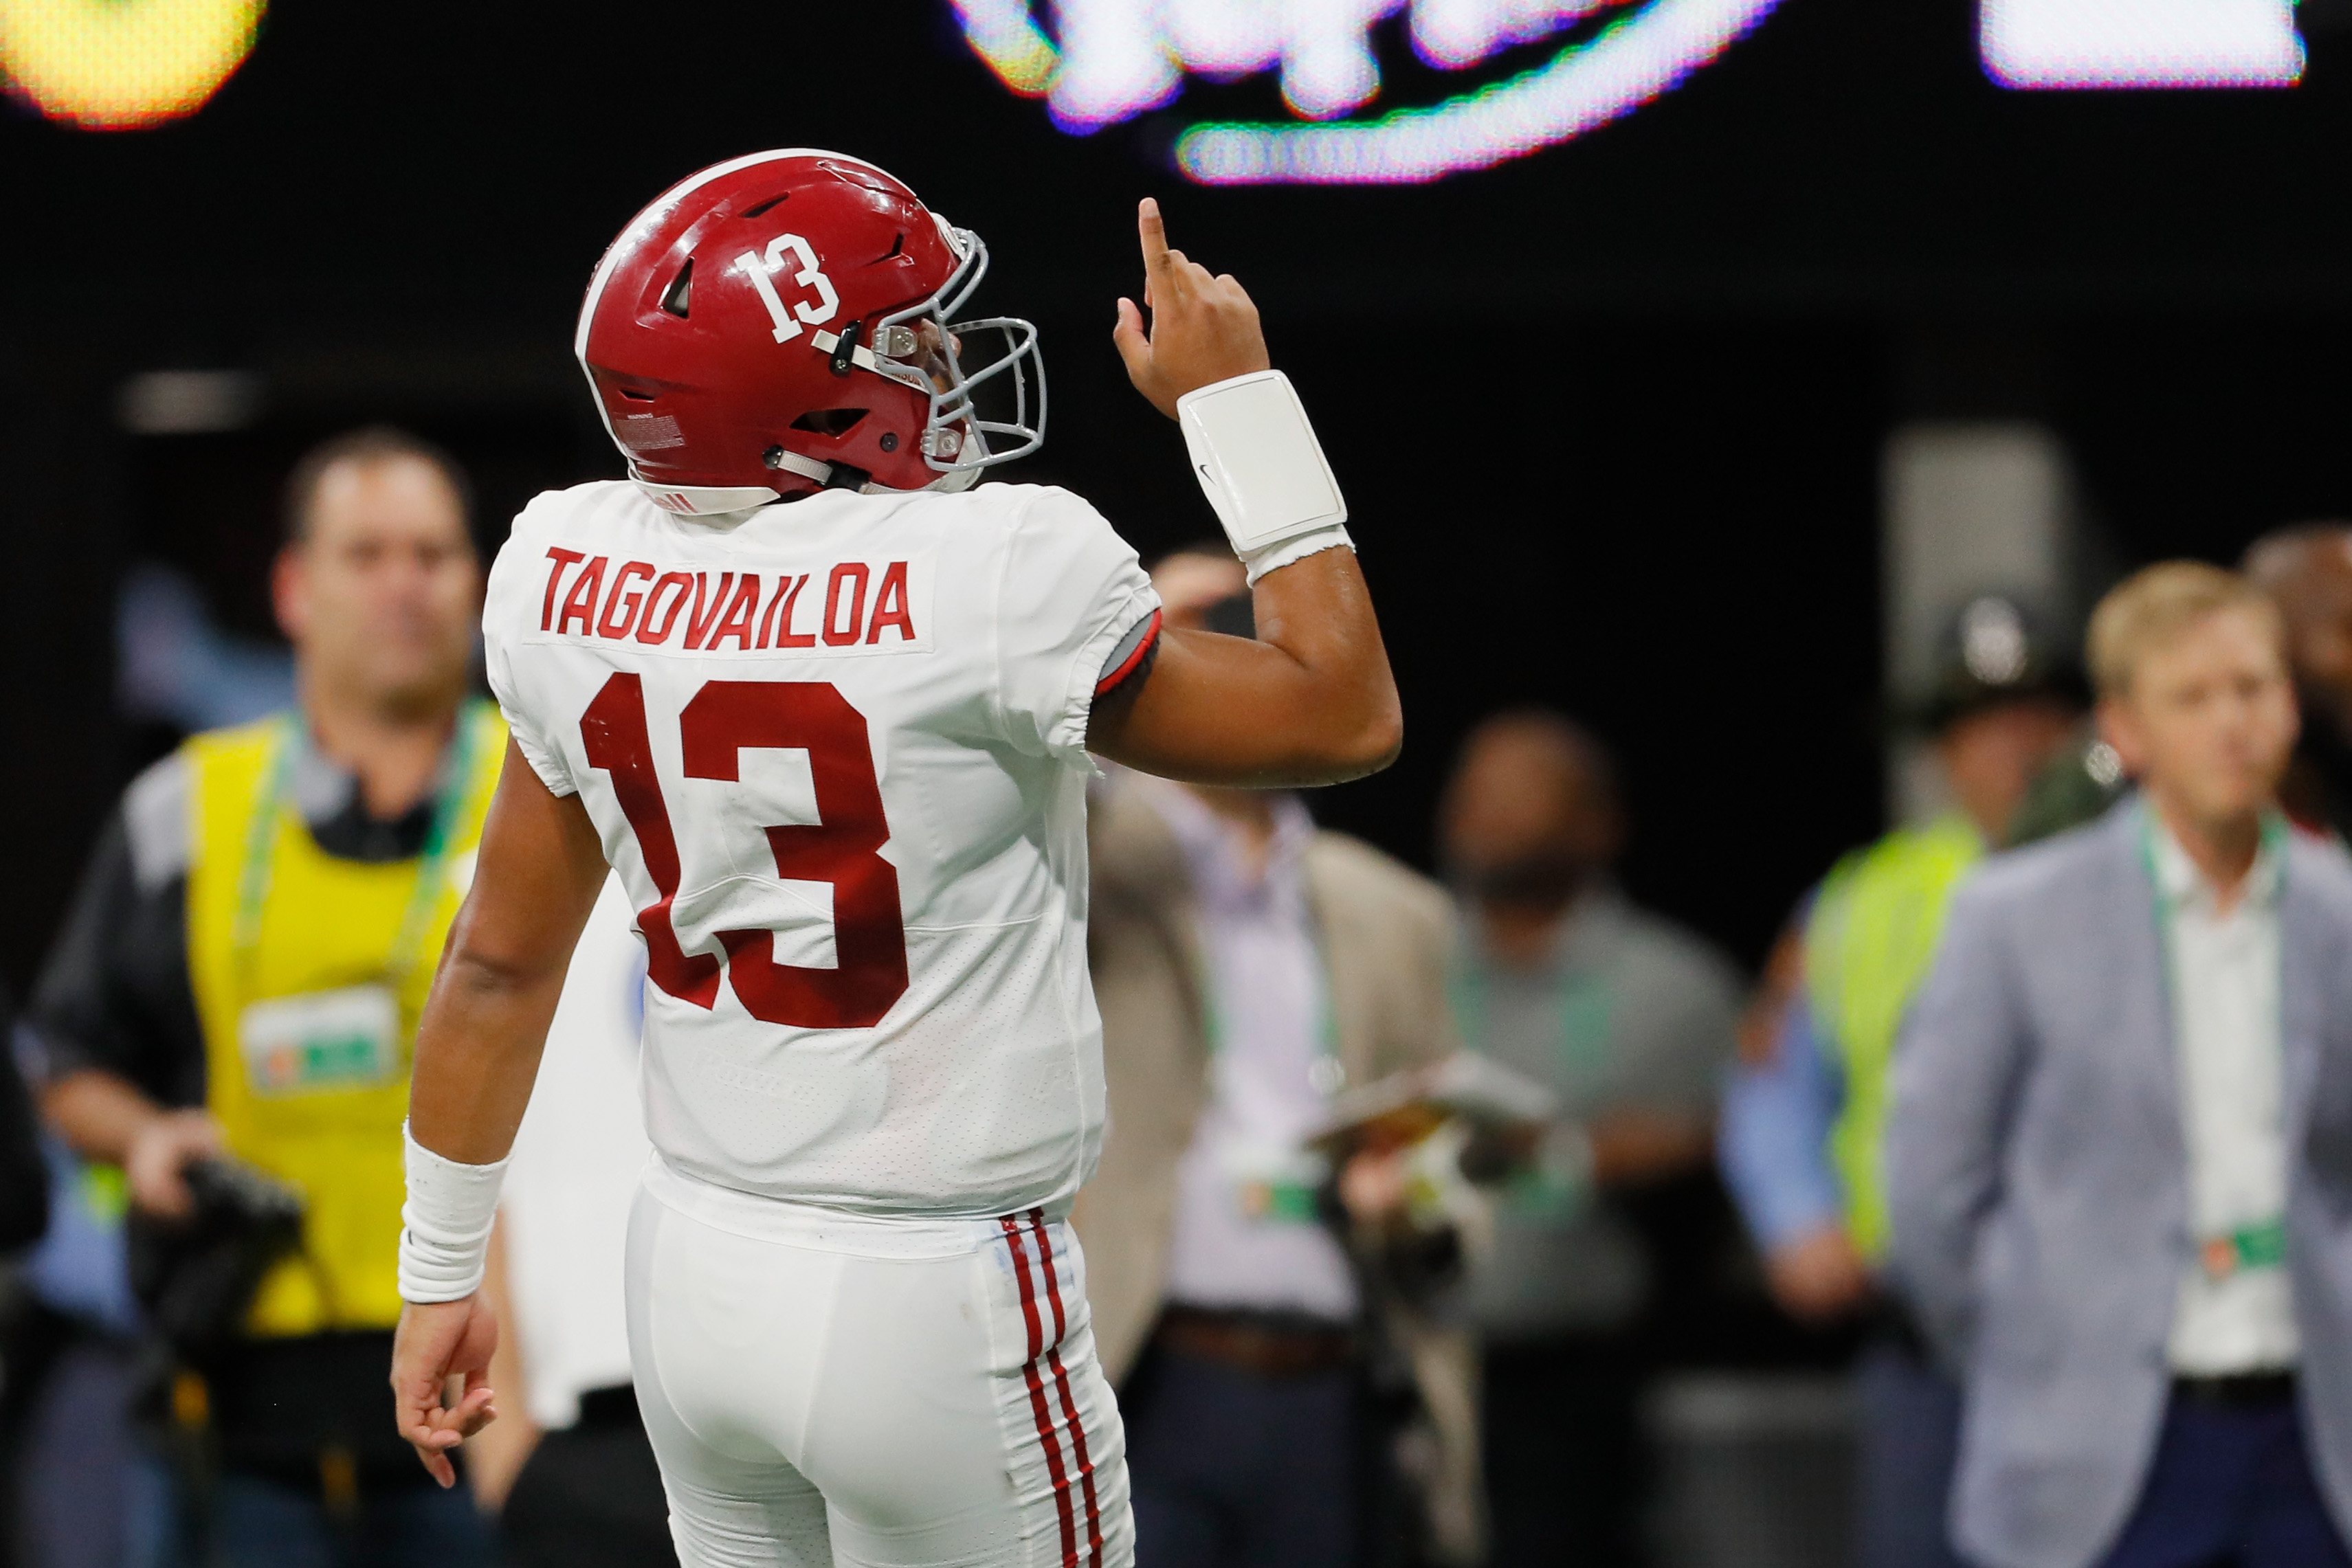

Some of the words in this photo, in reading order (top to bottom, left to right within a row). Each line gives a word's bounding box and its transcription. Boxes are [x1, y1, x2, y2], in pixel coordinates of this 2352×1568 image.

[733, 232, 841, 344] 13
[540, 546, 916, 651] TAGOVAILOA
[579, 671, 909, 1029] 13
